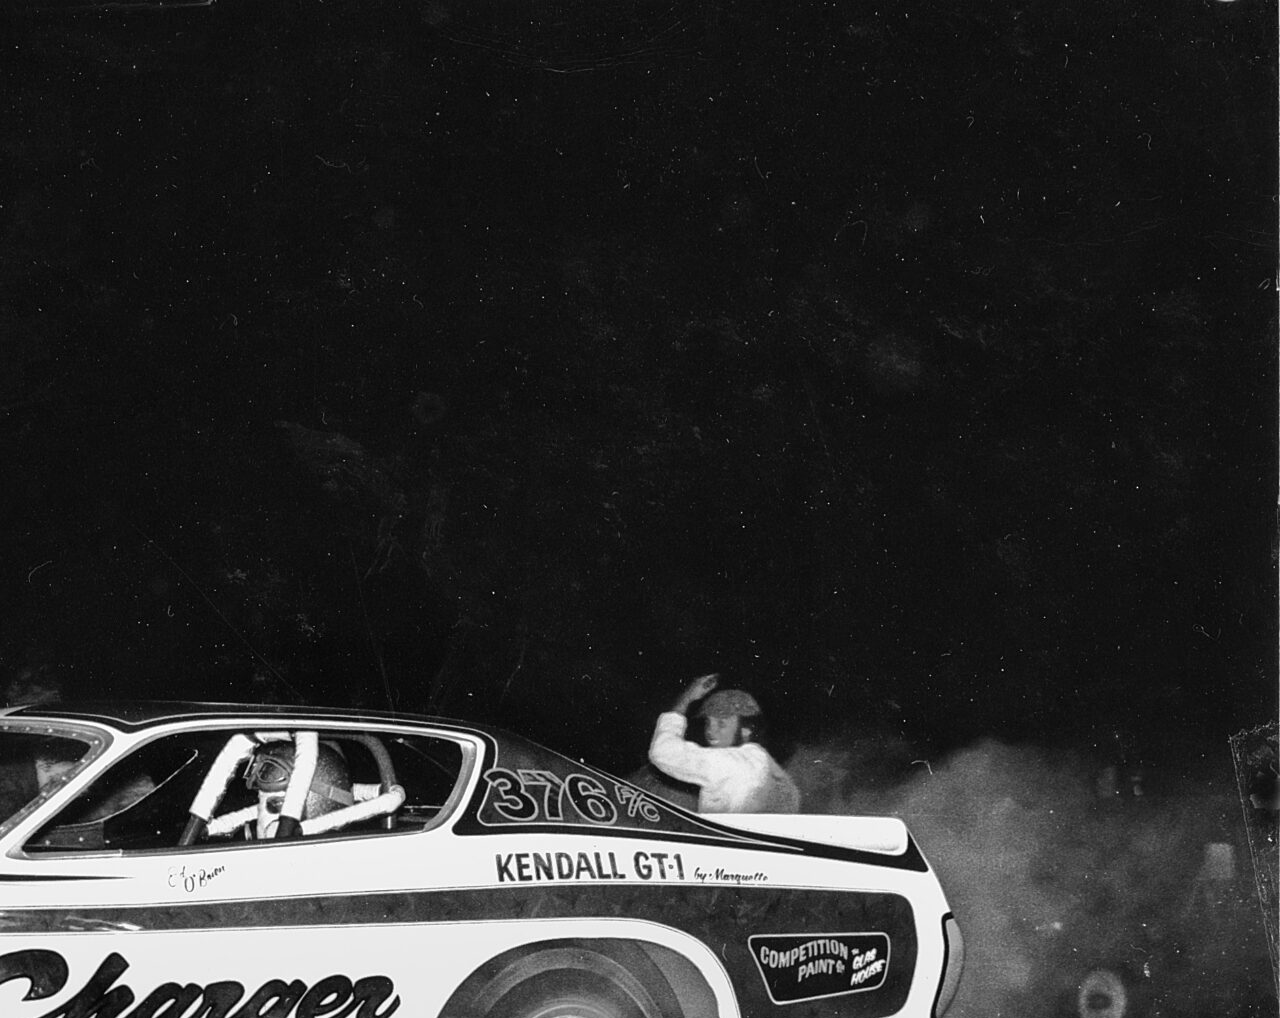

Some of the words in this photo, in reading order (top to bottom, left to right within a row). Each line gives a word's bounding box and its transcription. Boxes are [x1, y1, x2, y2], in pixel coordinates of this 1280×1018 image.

[483, 767, 618, 826] 376
[495, 851, 626, 882] KENDALL
[760, 939, 849, 969] COMPETITION
[797, 958, 835, 983] PAINT
